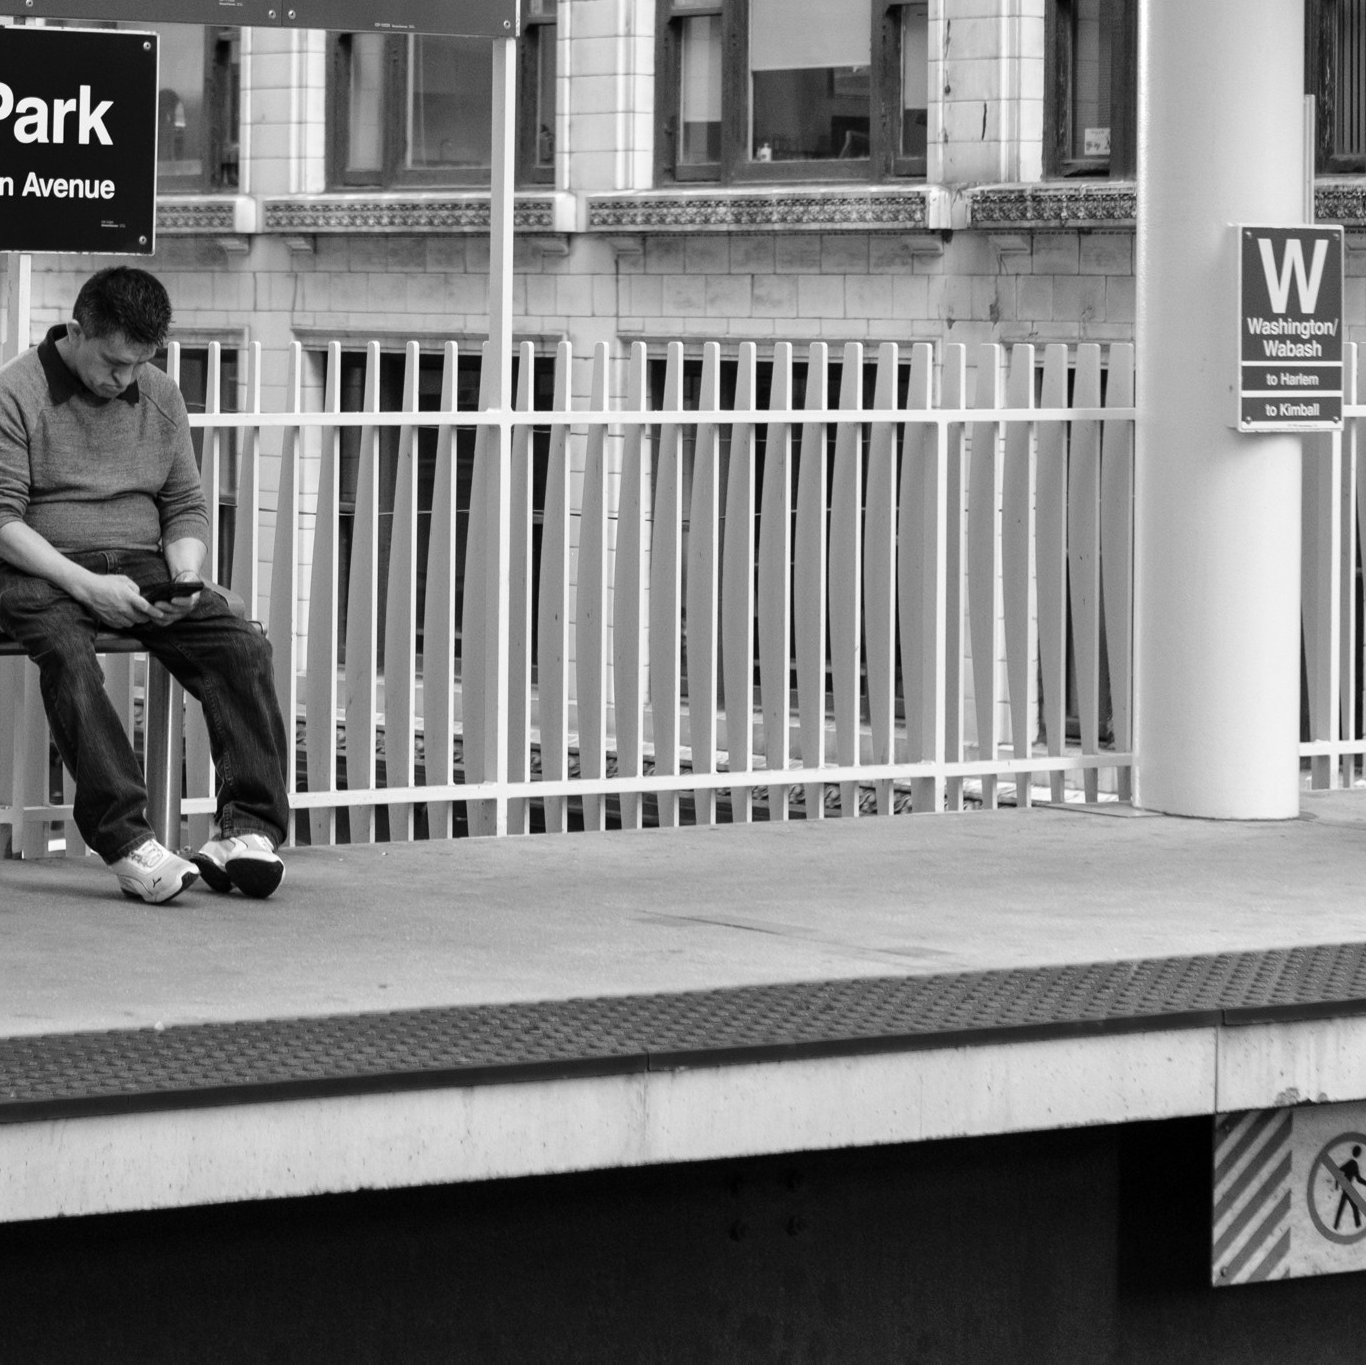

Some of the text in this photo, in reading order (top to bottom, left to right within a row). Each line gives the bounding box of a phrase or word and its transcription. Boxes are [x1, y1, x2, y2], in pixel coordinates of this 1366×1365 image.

[21, 171, 116, 200] Avenue
[1257, 238, 1329, 314] W
[1246, 317, 1339, 340] Washington/
[1262, 339, 1323, 358] Wabash
[1265, 372, 1320, 386] to Harlem
[1264, 402, 1320, 417] to Kimball
